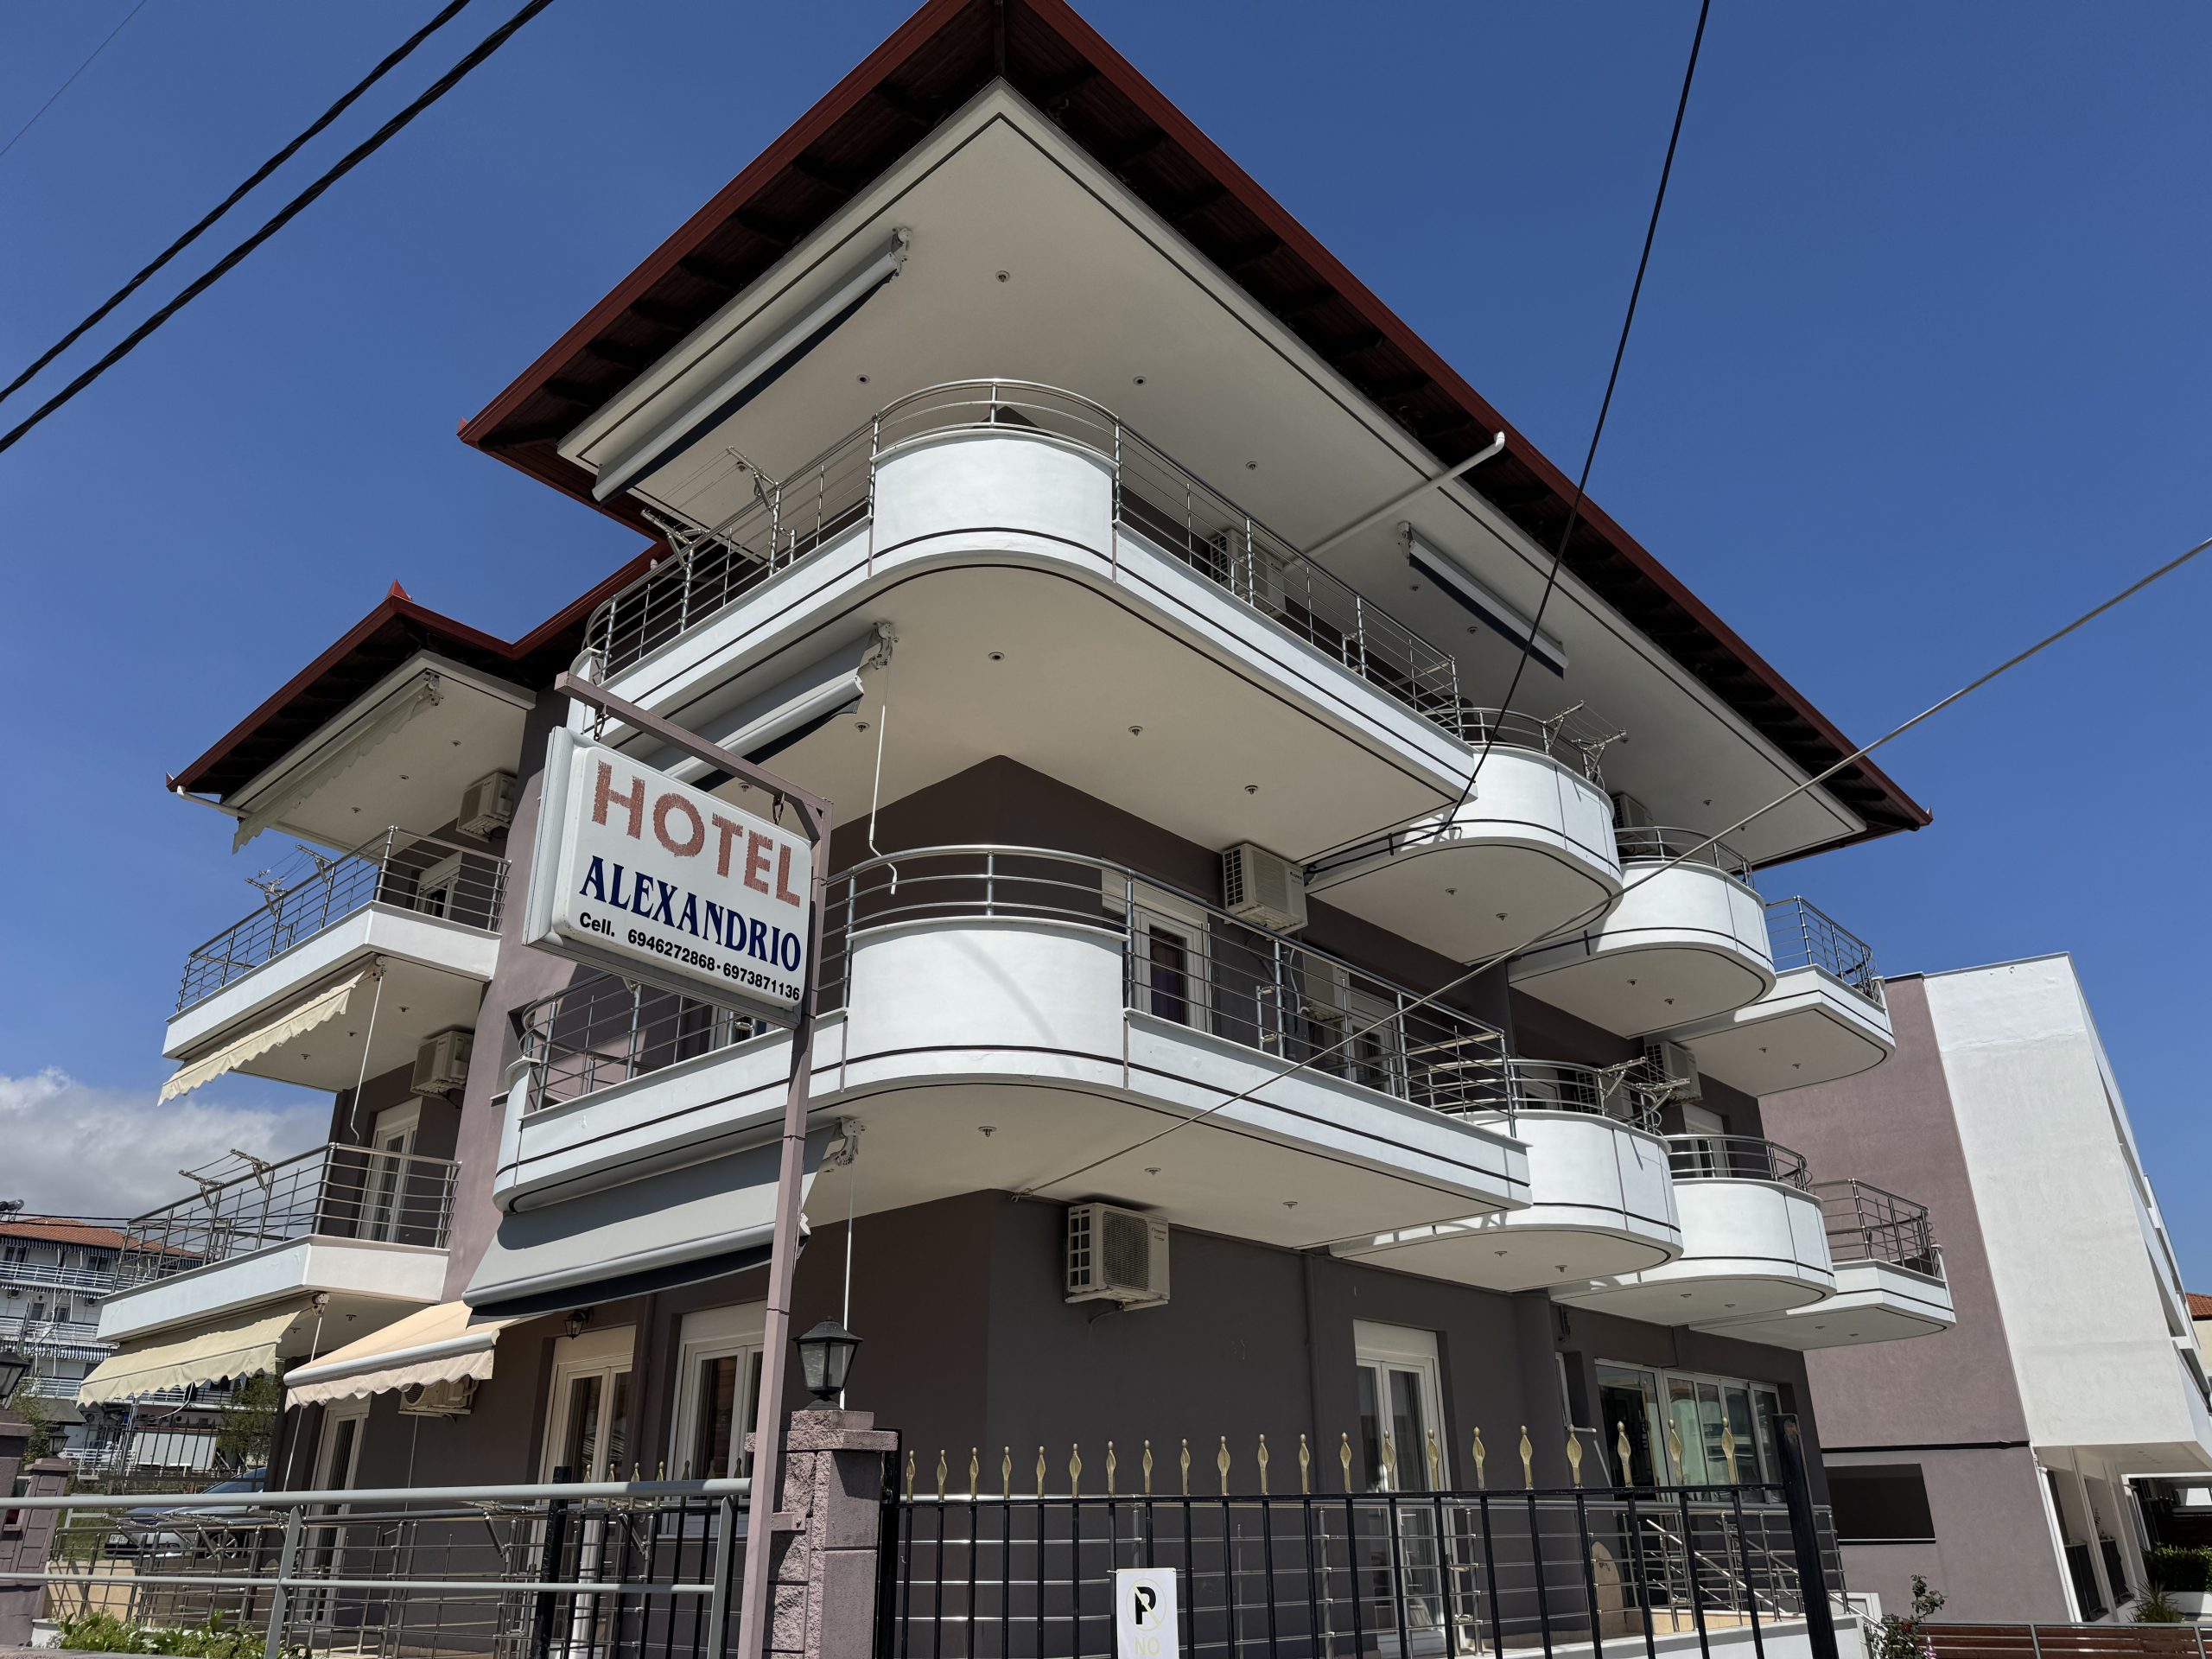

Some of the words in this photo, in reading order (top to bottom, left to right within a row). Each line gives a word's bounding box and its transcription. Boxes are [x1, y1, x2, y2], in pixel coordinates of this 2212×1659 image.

[592, 760, 801, 908] HOTEL
[579, 855, 801, 972] ALEXANDRIO
[579, 912, 615, 938] Cell.
[1135, 1586, 1156, 1624] P
[1135, 1637, 1160, 1656] NO
